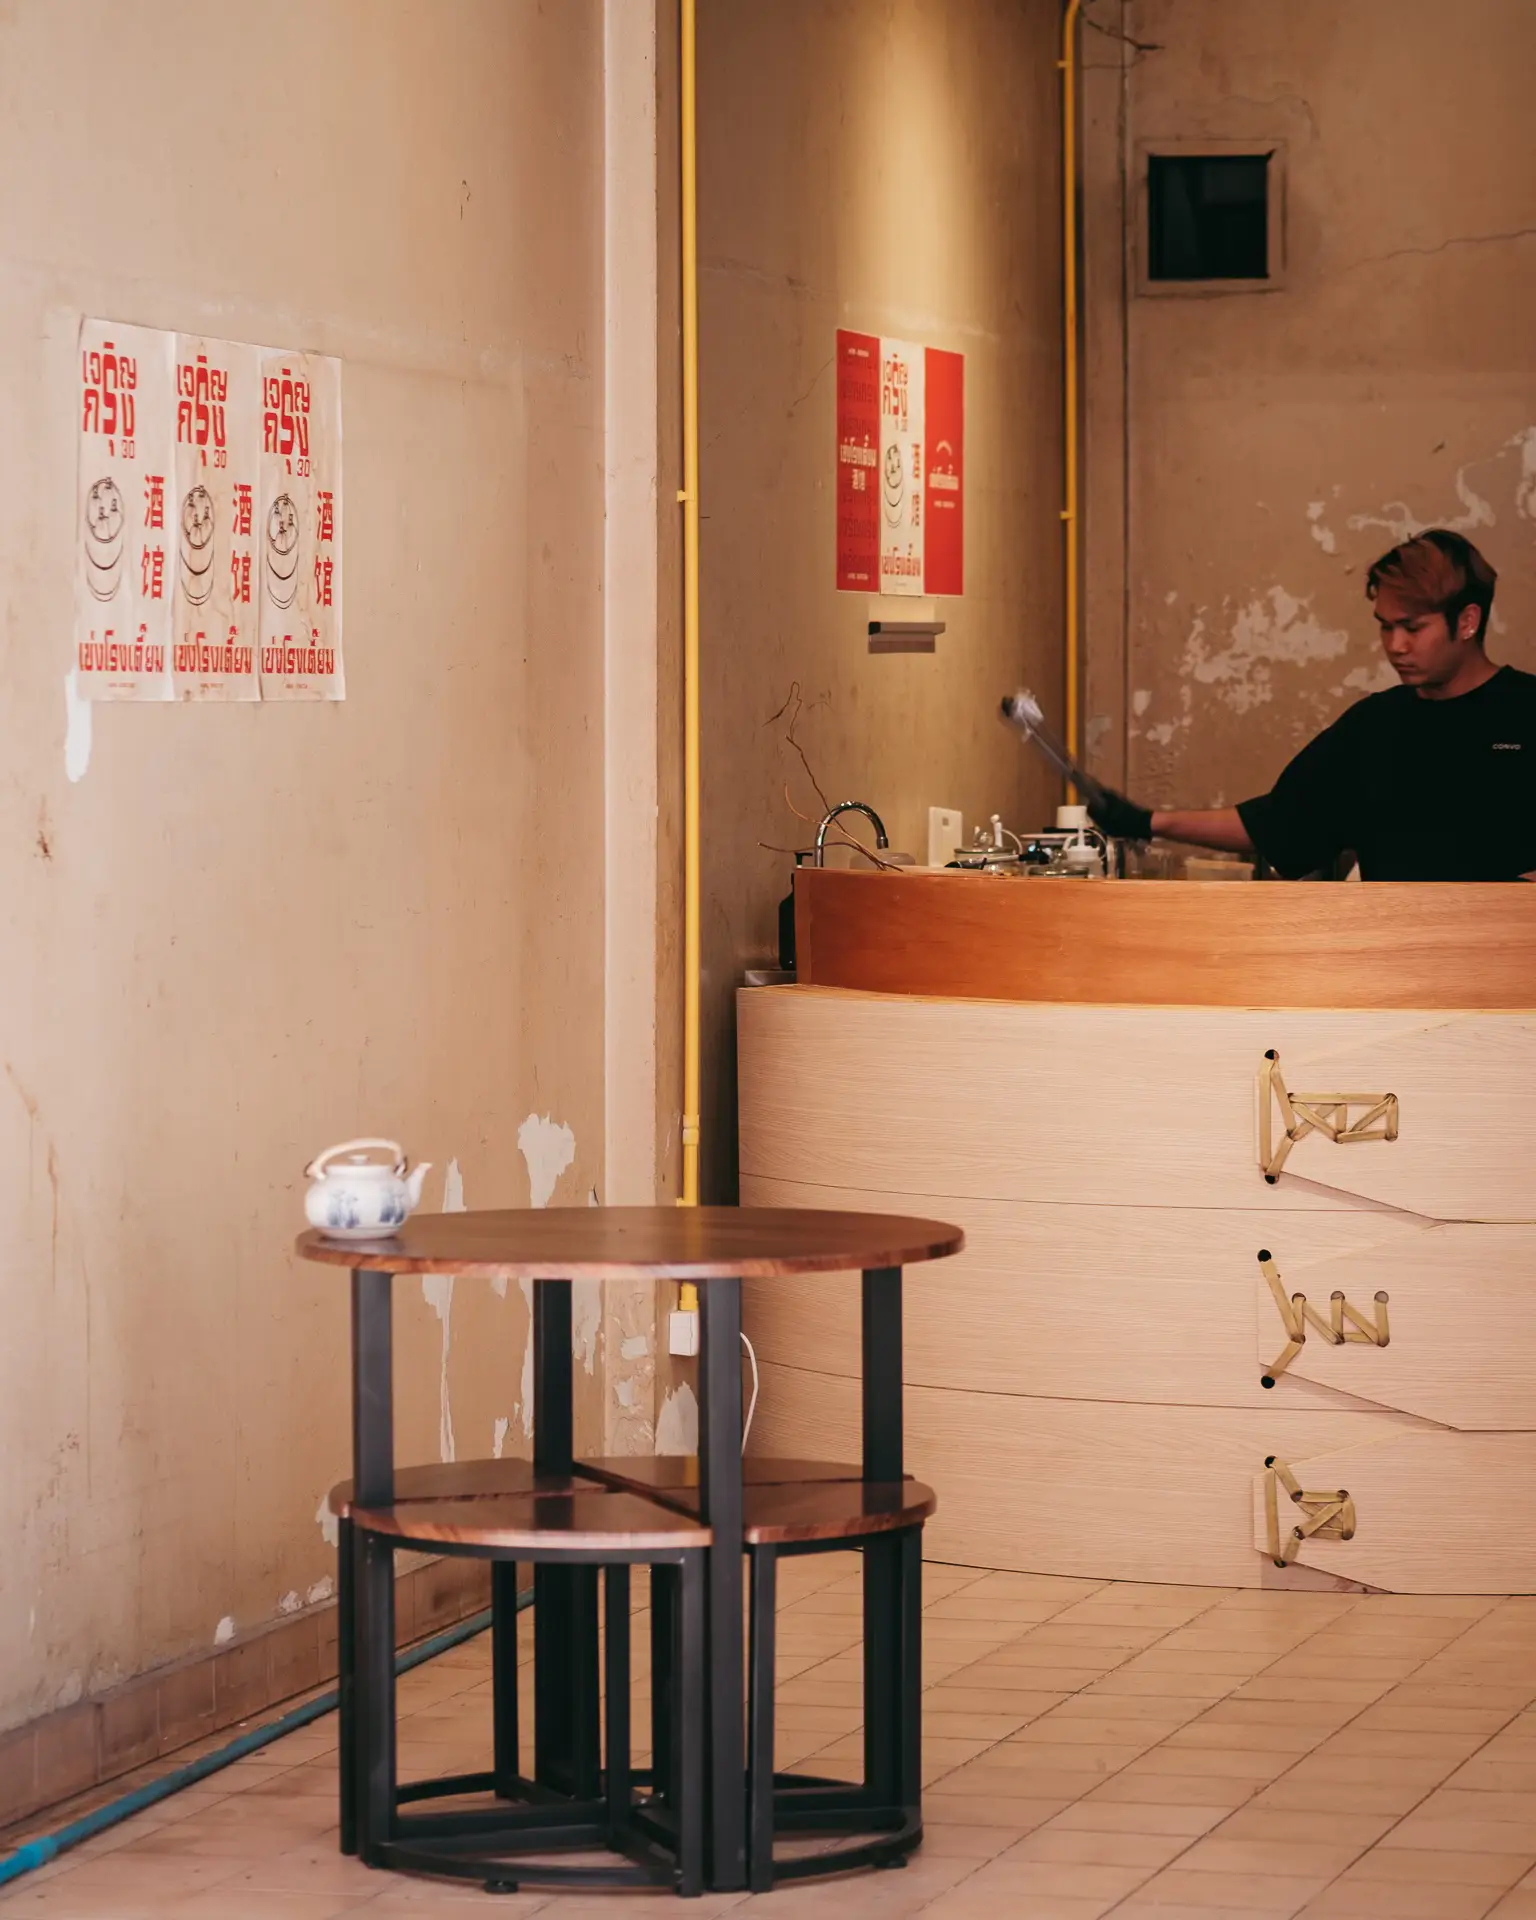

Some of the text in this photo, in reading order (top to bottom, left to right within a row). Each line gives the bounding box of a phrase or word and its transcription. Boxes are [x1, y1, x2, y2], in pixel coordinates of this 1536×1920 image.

[121, 439, 135, 459] 30
[213, 449, 228, 469] 30
[296, 458, 311, 478] 30
[141, 474, 165, 599] 酒馆
[230, 483, 252, 604] 酒馆
[314, 491, 334, 607] 酒馆
